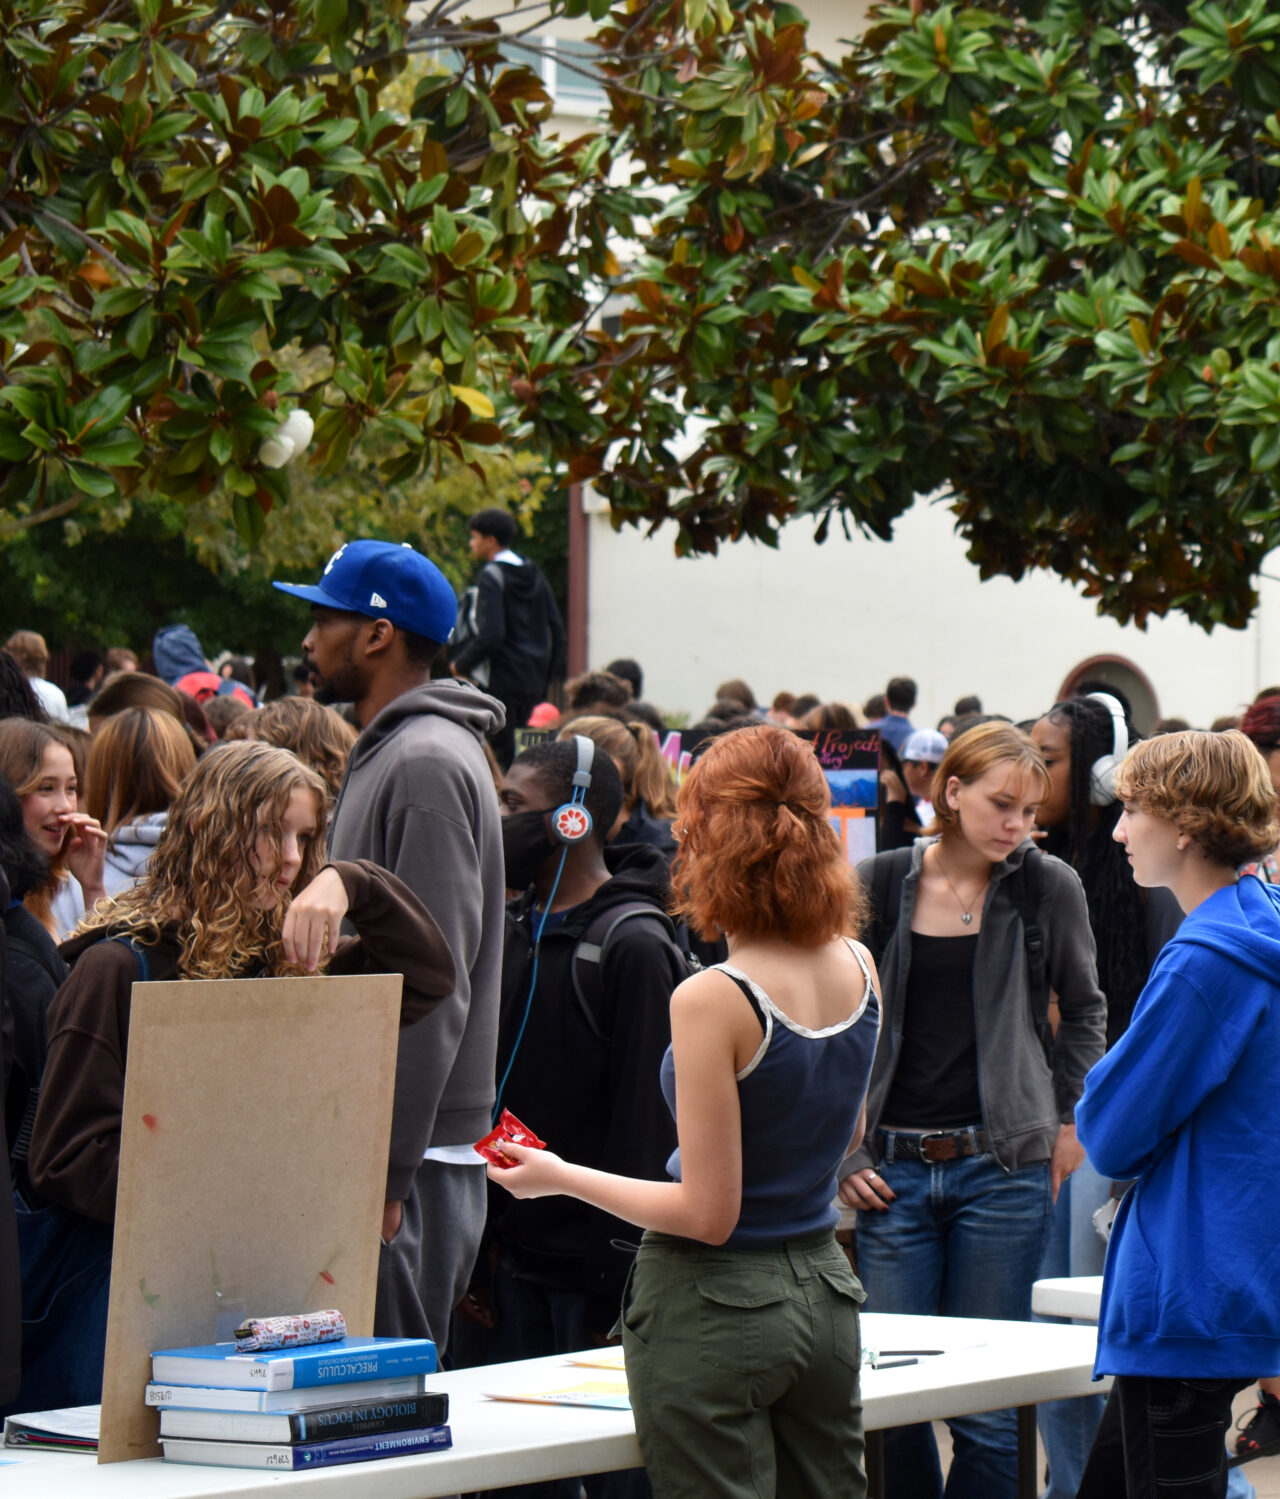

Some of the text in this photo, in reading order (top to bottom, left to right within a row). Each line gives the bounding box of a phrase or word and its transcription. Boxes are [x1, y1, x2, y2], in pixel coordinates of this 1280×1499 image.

[317, 1361, 378, 1379] PRECALCULUS
[317, 1402, 417, 1426] BIOLOGY IN FOCUS
[375, 1435, 430, 1451] ENVIRONMENT
